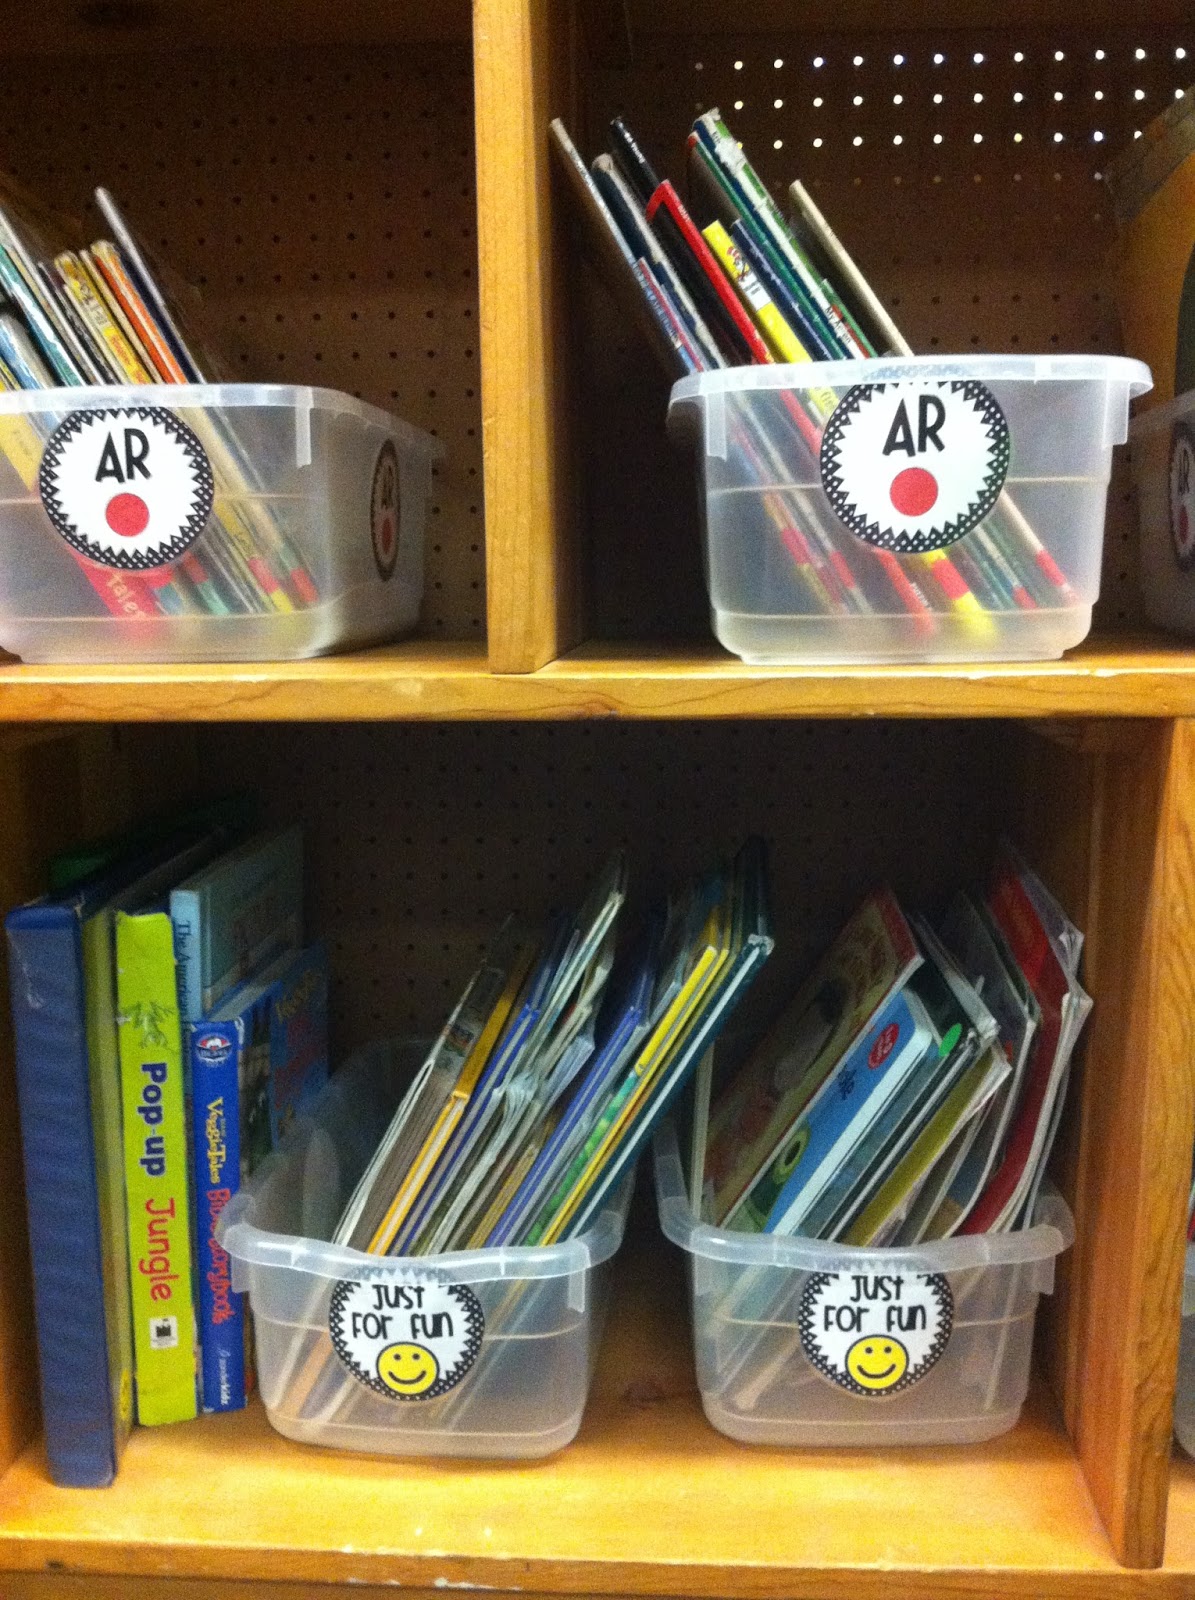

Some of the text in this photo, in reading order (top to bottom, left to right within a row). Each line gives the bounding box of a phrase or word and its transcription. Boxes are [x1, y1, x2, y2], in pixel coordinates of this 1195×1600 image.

[95, 427, 152, 484] AR
[882, 392, 946, 458] AR
[207, 1097, 226, 1184] VeggieTales
[138, 1062, 179, 1302] Pop-up Jungle
[371, 1284, 425, 1310] JUST
[850, 1275, 904, 1302] JUST
